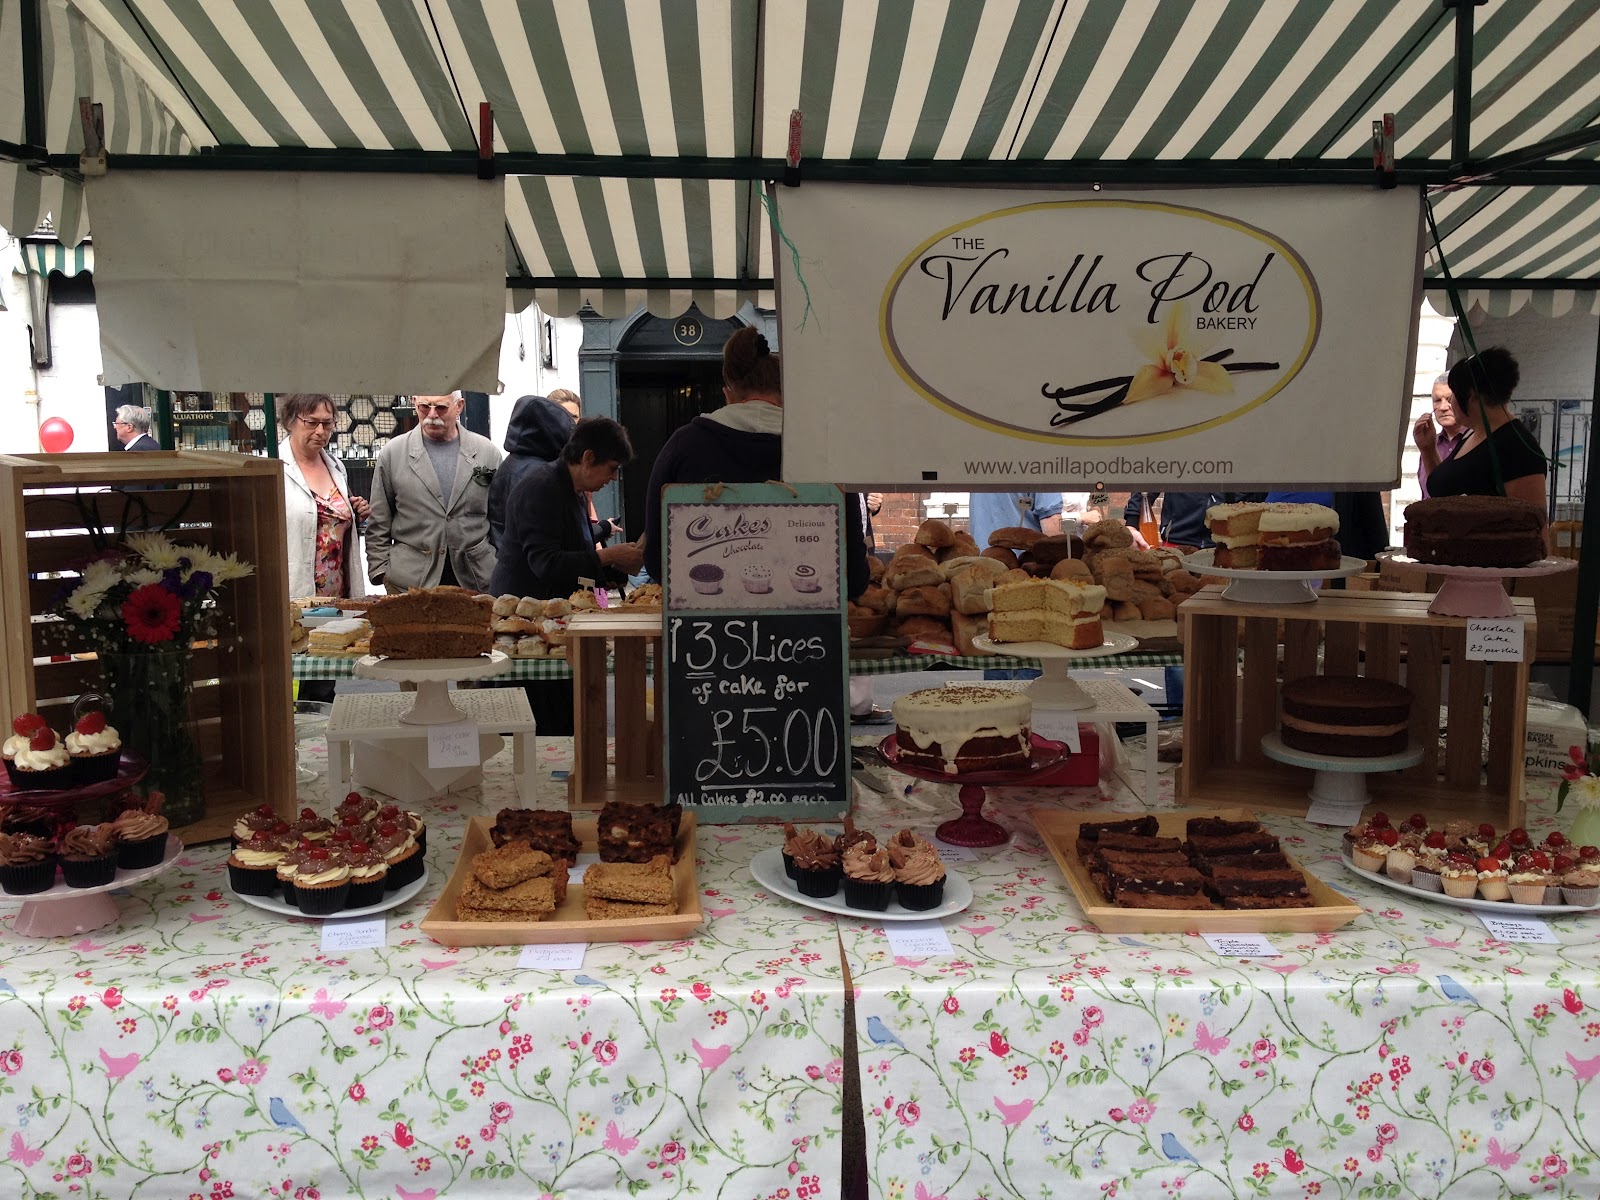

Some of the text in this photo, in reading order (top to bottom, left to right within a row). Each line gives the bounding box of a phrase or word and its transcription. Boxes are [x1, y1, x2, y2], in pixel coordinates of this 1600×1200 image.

[952, 236, 985, 251] THE
[920, 248, 1276, 324] Vanilla Pod
[680, 324, 696, 337] 38
[1196, 316, 1258, 331] BAKERY
[963, 455, 1234, 480] www.vanillapodbakery.com
[685, 512, 826, 543] Cakes Delicious
[794, 535, 820, 543] 1860
[722, 540, 764, 558] Chocolate
[1469, 623, 1516, 634] Chocolate
[1483, 634, 1511, 643] Cake
[1470, 644, 1483, 652] £2
[692, 673, 810, 705] of cake for
